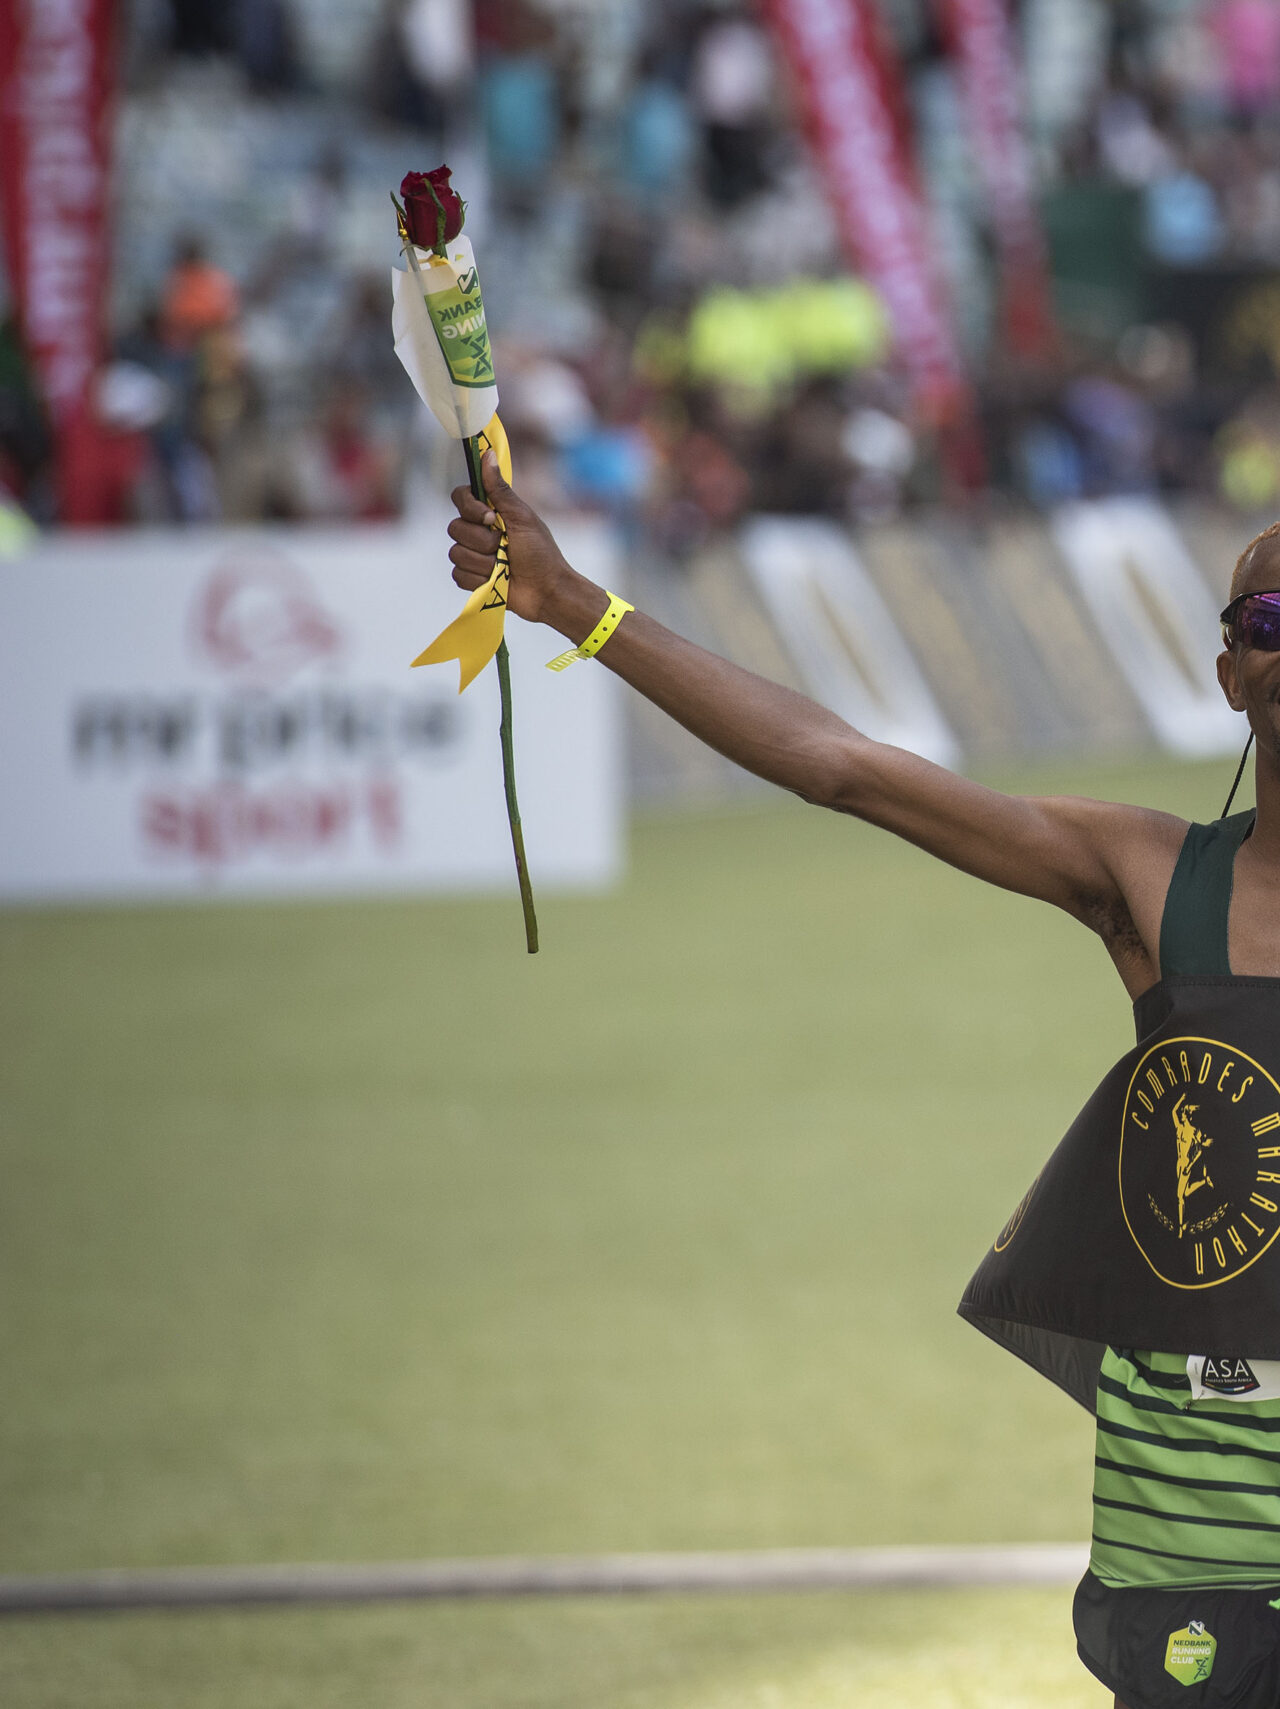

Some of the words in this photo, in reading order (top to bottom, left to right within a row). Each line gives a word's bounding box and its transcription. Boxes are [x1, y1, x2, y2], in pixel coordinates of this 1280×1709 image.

[1131, 1050, 1254, 1130] COMRADES
[1205, 1358, 1250, 1378] ASA
[1172, 1647, 1211, 1655] RUNNING
[1170, 1656, 1195, 1664] CLUB
